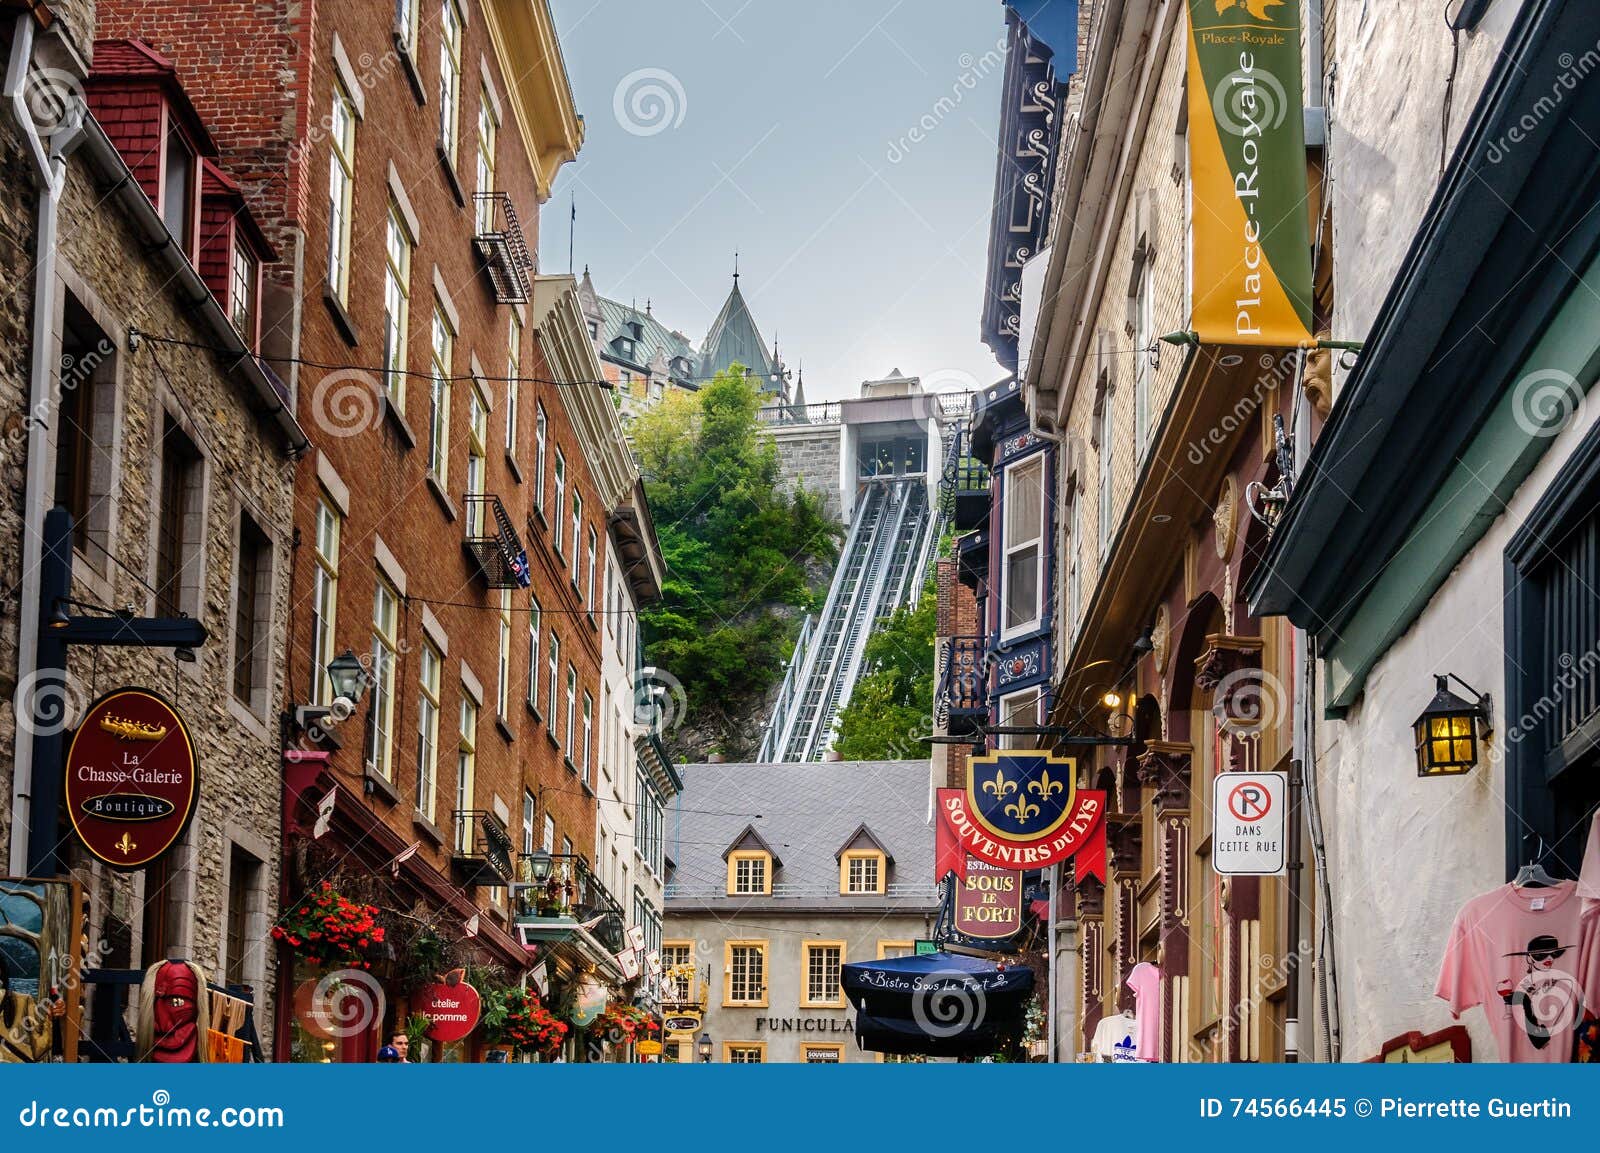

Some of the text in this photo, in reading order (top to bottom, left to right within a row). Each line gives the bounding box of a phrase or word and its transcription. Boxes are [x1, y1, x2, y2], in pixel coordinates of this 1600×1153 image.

[1202, 31, 1285, 46] Place-Royale
[1231, 50, 1262, 337] Place-Royale
[123, 752, 139, 765] La
[78, 766, 183, 784] Chasse-Galerie
[95, 800, 163, 815] Boutique
[946, 797, 1098, 863] SOUVENIRS DU LYS
[1235, 825, 1262, 836] DANS
[1219, 841, 1277, 852] CETTE RUE
[965, 875, 1014, 891] SOUS
[981, 892, 997, 904] LE
[962, 906, 1016, 923] FORT
[873, 971, 989, 991] Bistro Sous Le Fort
[433, 1012, 468, 1022] pomme
[756, 1017, 855, 1032] FUNICULA
